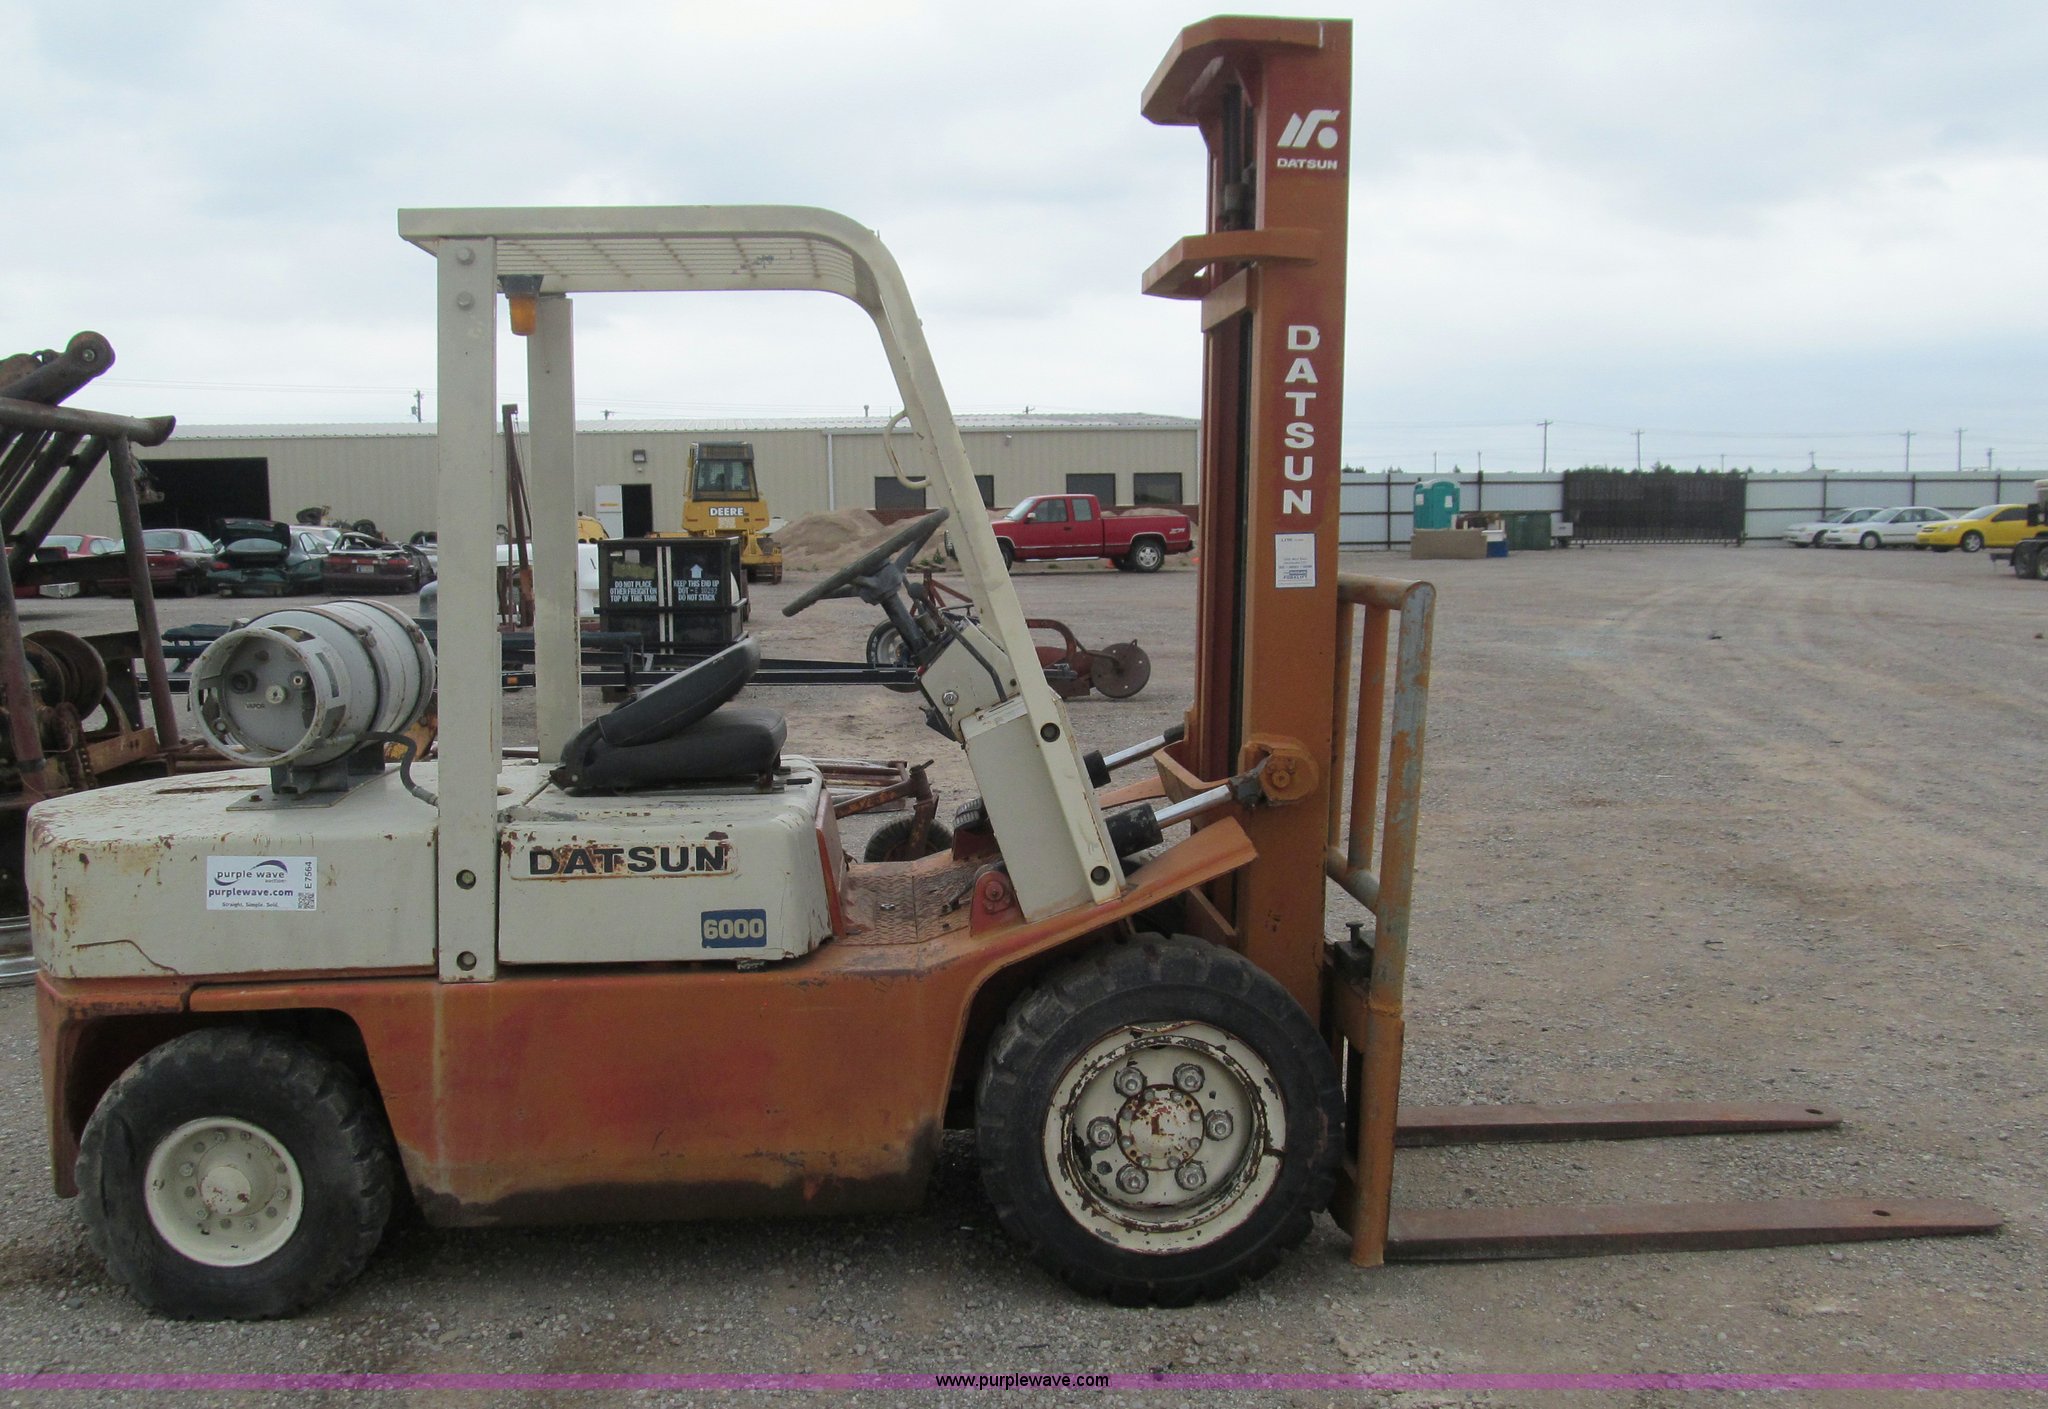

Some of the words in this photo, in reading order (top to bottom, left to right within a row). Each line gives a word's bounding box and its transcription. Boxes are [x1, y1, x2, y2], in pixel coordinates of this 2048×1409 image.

[1276, 158, 1339, 170] DATSUN
[1282, 325, 1321, 515] DATSUN
[710, 507, 744, 516] DEERE
[614, 580, 623, 588] DO
[623, 580, 634, 588] NOT
[635, 580, 652, 588] PLACE
[609, 587, 627, 595] OTHER
[628, 587, 650, 595] FREIGHT
[610, 594, 621, 602] TOP
[622, 594, 629, 602] OF
[630, 594, 643, 602] THIS
[644, 594, 657, 602] TANK
[529, 845, 727, 875] DATSUN
[217, 870, 252, 879] purple
[256, 871, 285, 879] wave
[304, 861, 312, 882] 7564
[208, 888, 294, 898] purplewave.com
[703, 918, 765, 940] 6000
